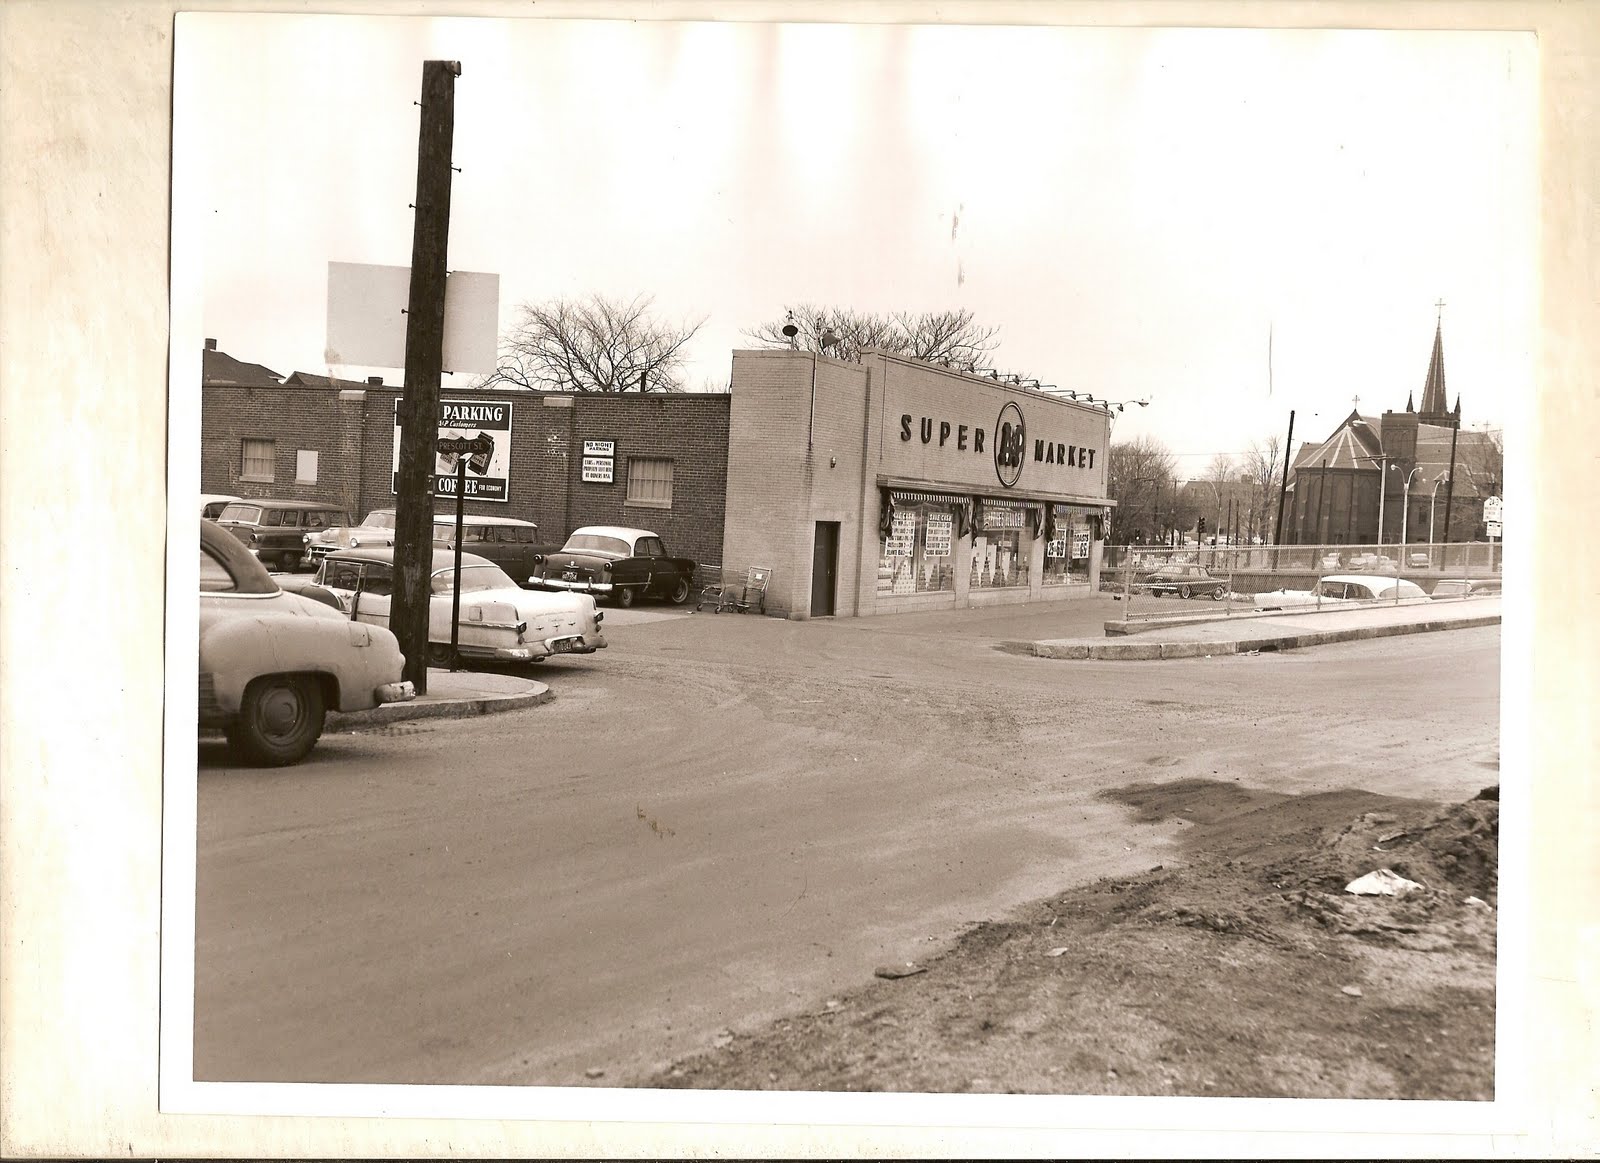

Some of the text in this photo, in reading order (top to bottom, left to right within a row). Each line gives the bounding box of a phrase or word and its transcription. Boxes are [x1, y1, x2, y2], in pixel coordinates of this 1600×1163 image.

[442, 405, 503, 421] PARKING
[438, 441, 471, 450] PRESCOTT
[900, 413, 985, 454] SUPER
[1034, 439, 1096, 469] MARKET
[438, 477, 478, 494] COFEE
[486, 484, 502, 492] ECONOMY
